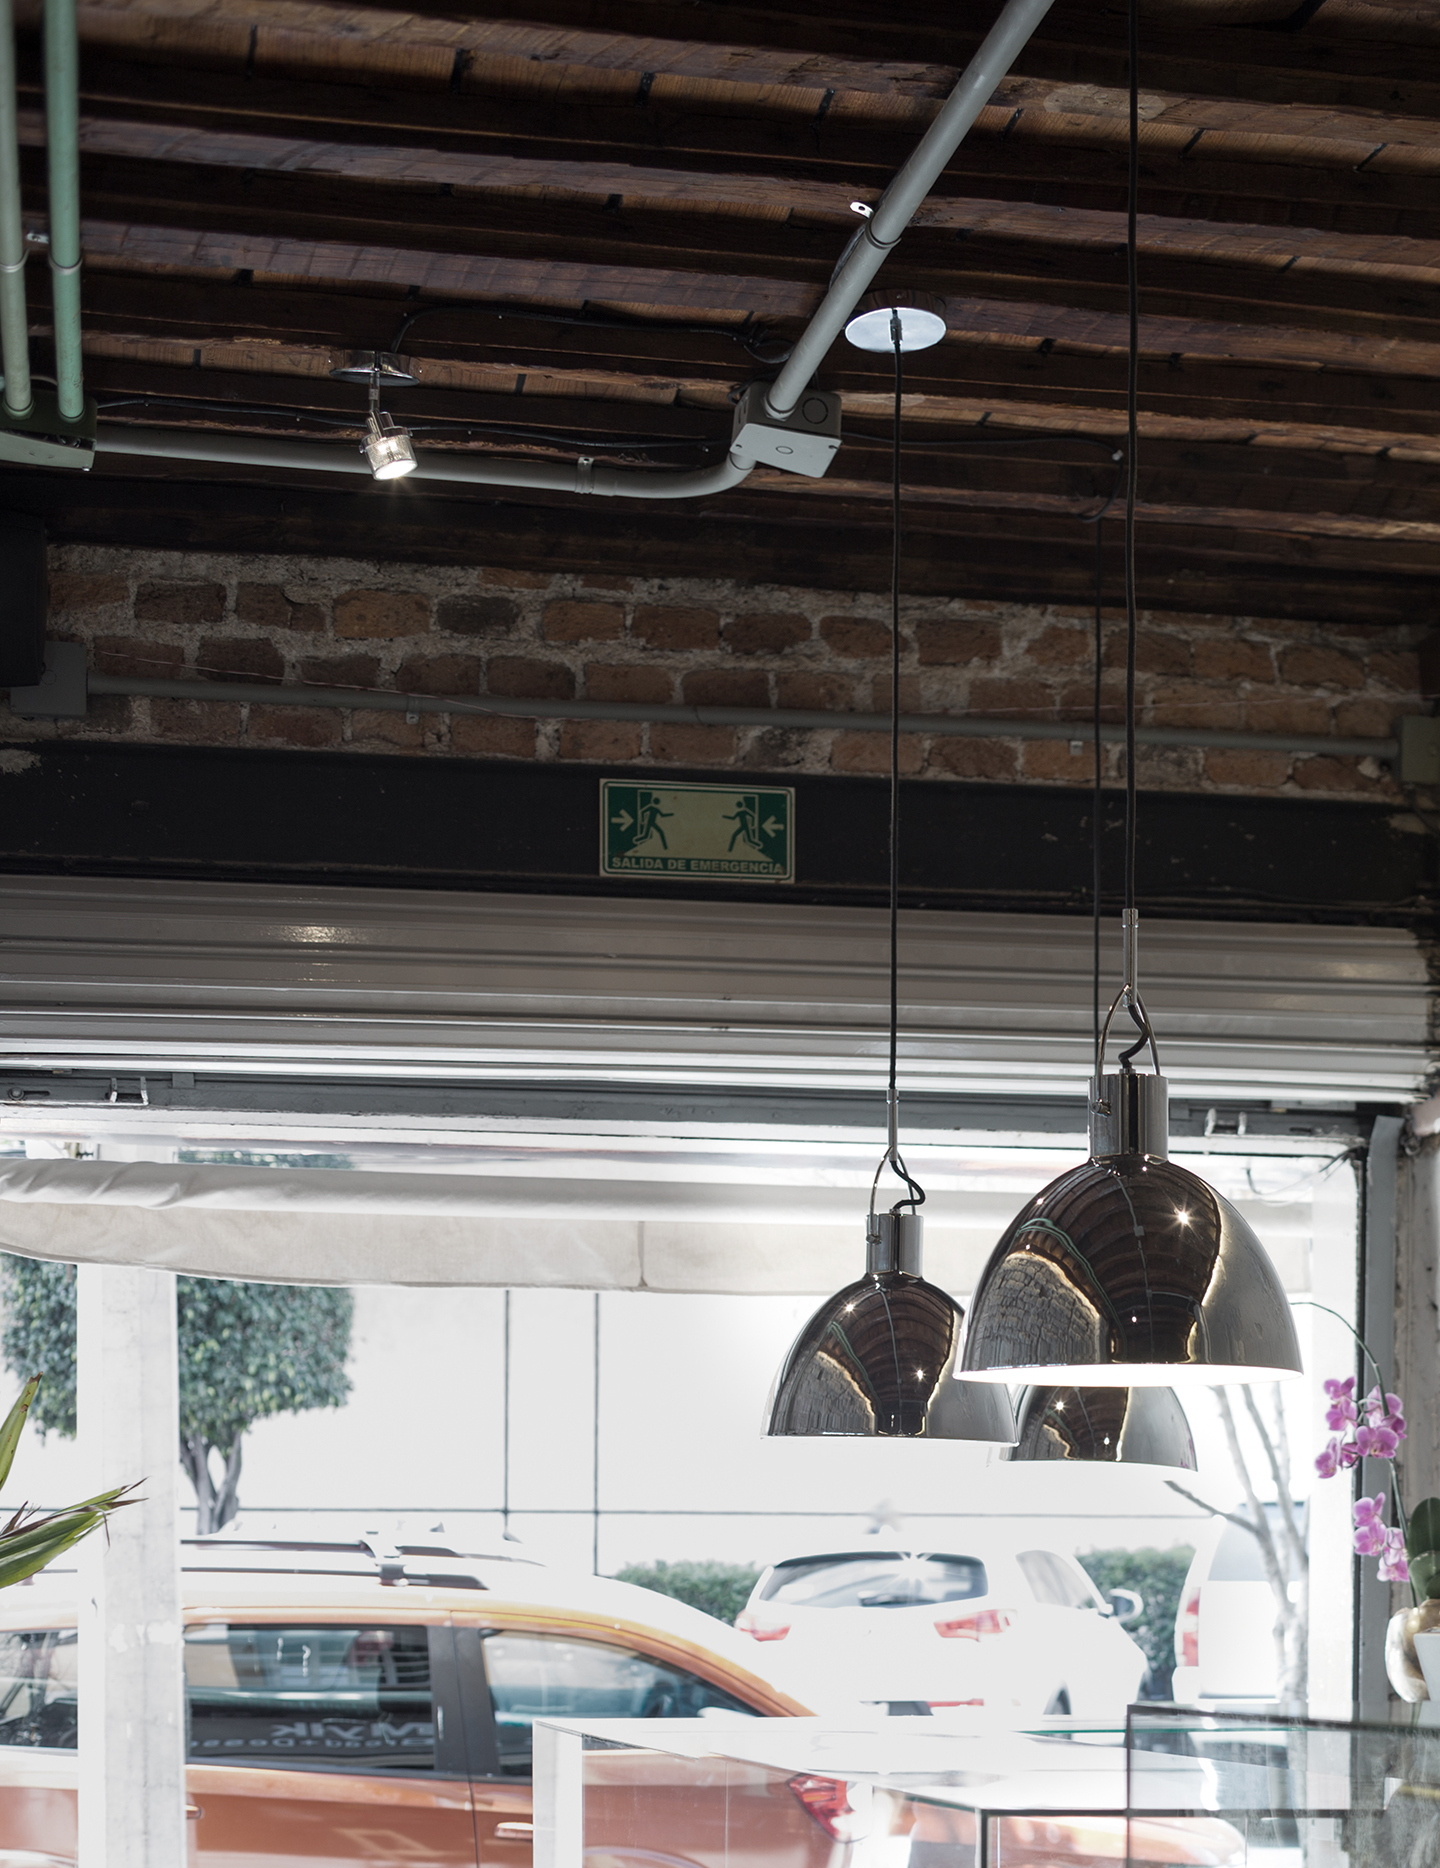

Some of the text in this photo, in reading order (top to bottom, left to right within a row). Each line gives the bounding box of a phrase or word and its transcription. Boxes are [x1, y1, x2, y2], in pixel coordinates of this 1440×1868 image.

[612, 857, 783, 875] SALIDA DE EMERGENCIA
